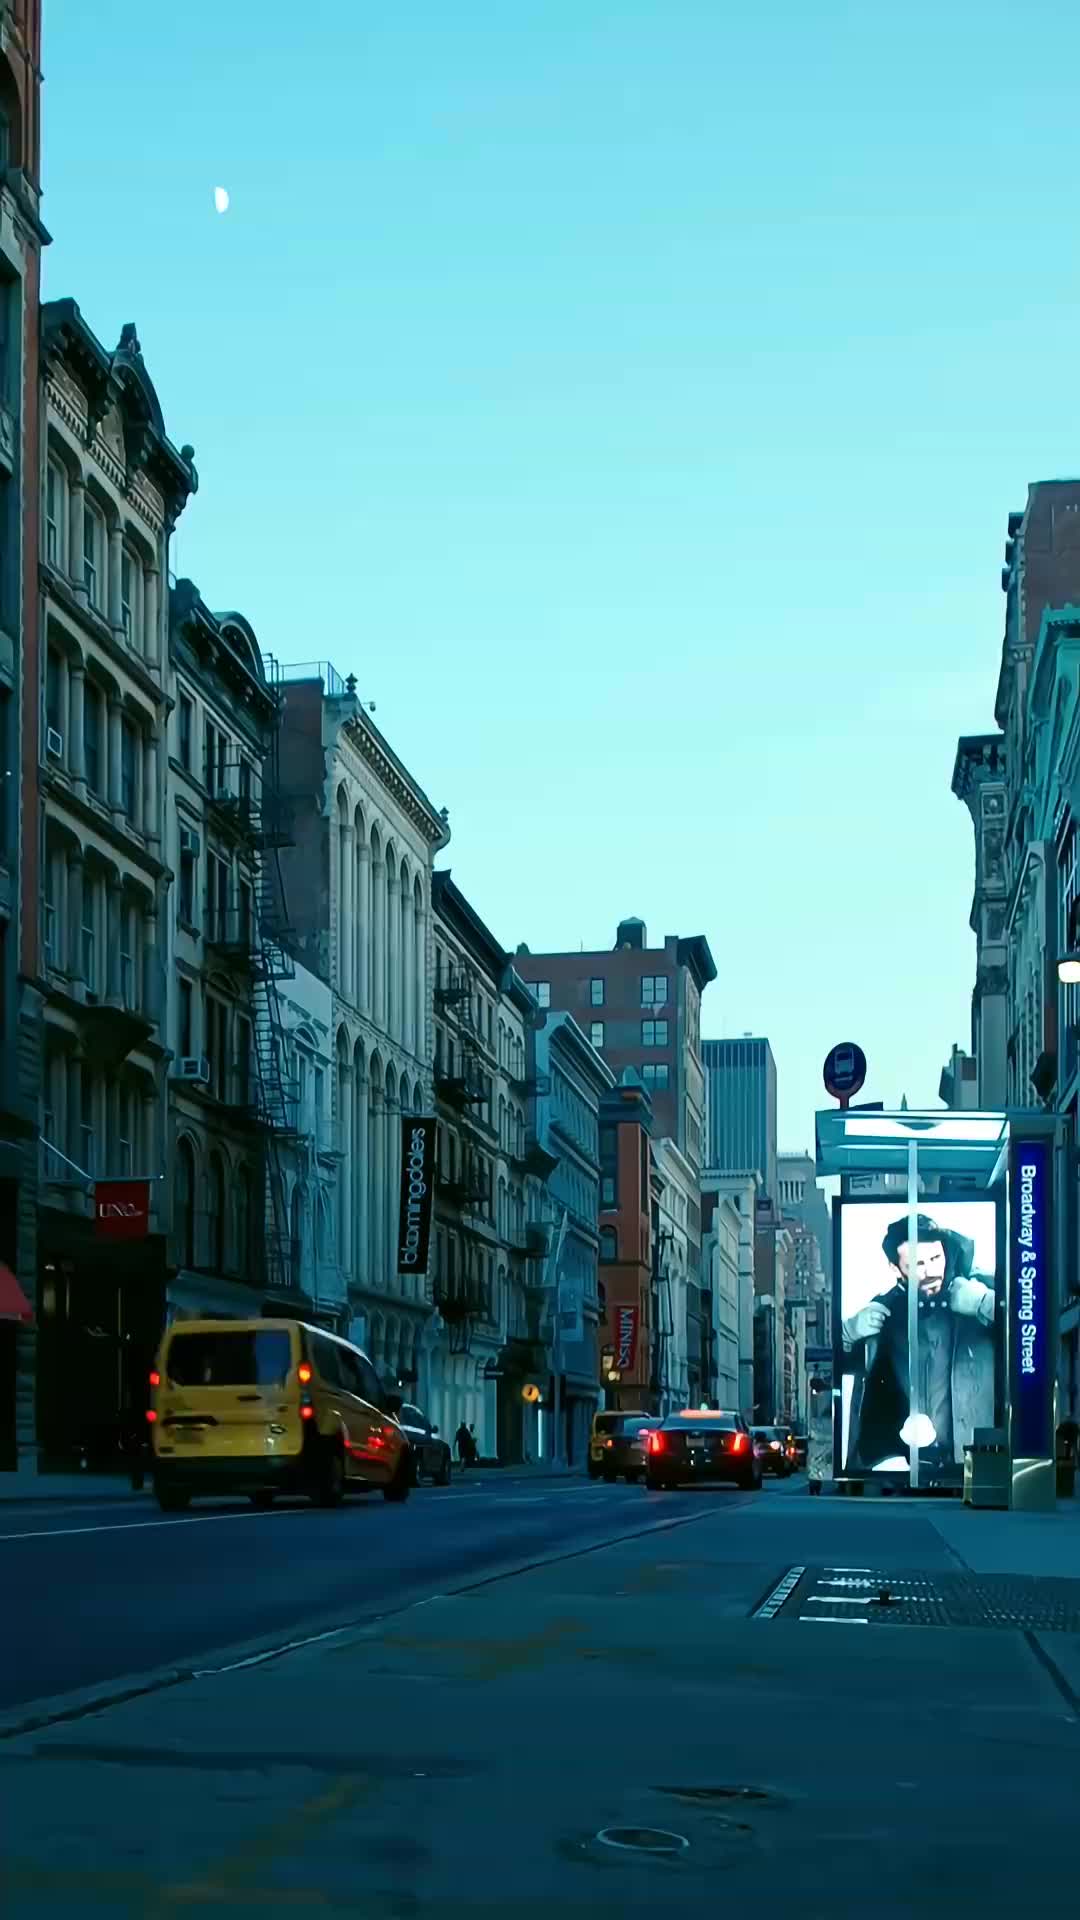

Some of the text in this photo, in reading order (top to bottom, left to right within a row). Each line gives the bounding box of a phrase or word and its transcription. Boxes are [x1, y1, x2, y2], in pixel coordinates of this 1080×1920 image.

[1017, 1165, 1037, 1375] Broadway & Spring Street
